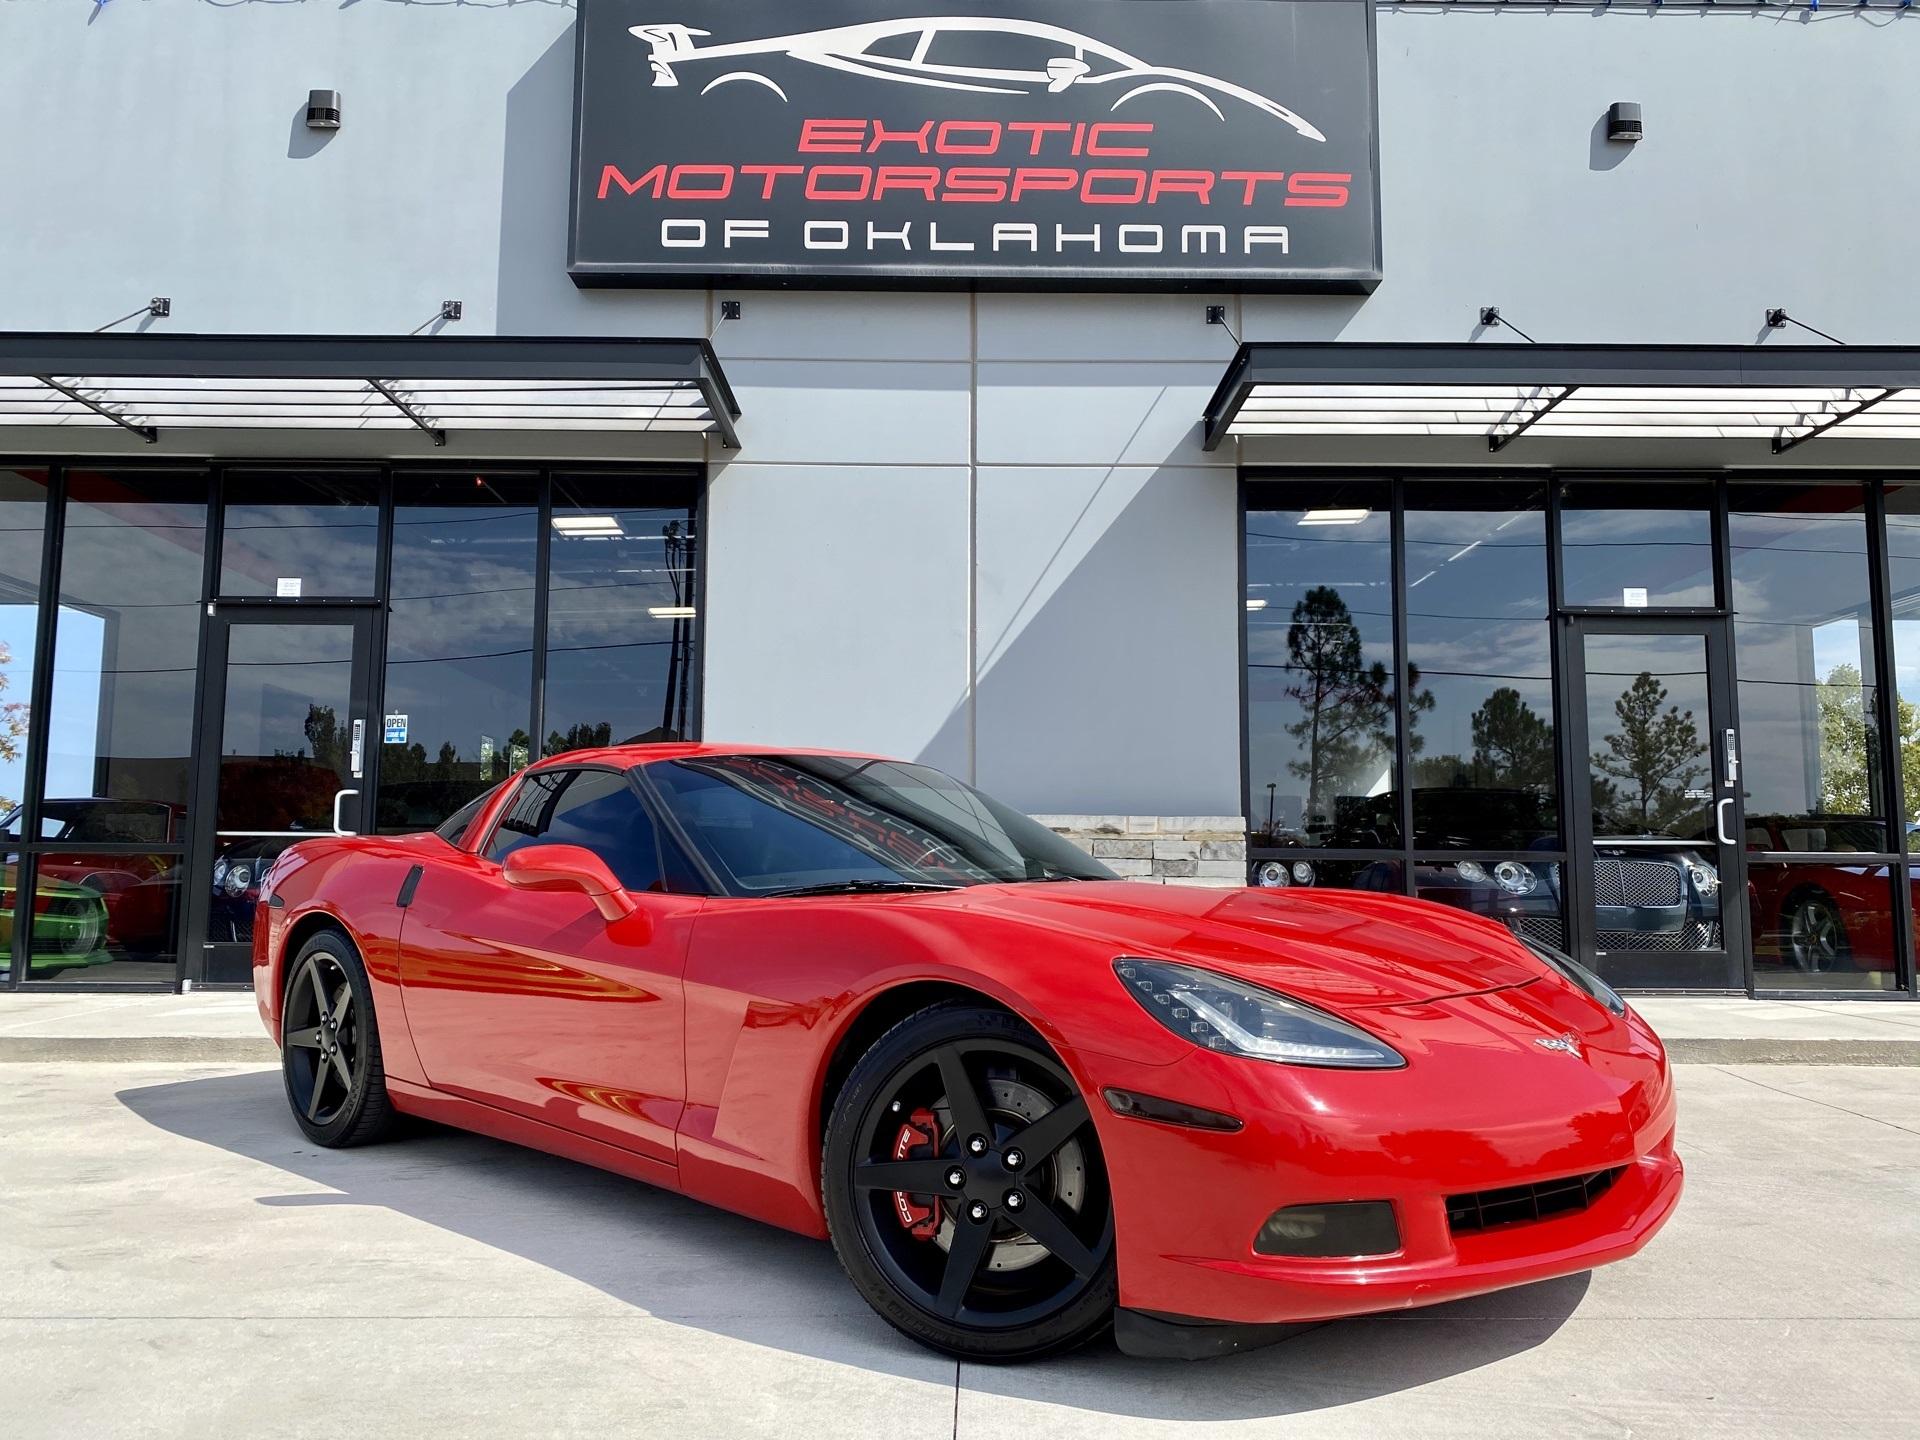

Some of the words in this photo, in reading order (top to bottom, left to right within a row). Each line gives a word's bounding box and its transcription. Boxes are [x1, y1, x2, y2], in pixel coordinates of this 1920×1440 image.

[797, 119, 1154, 158] EXOTIC
[597, 163, 1351, 208] MOTORSPORTS
[660, 218, 770, 249] OF
[802, 220, 1290, 255] OKLAHOMA
[386, 718, 407, 728] OPEN
